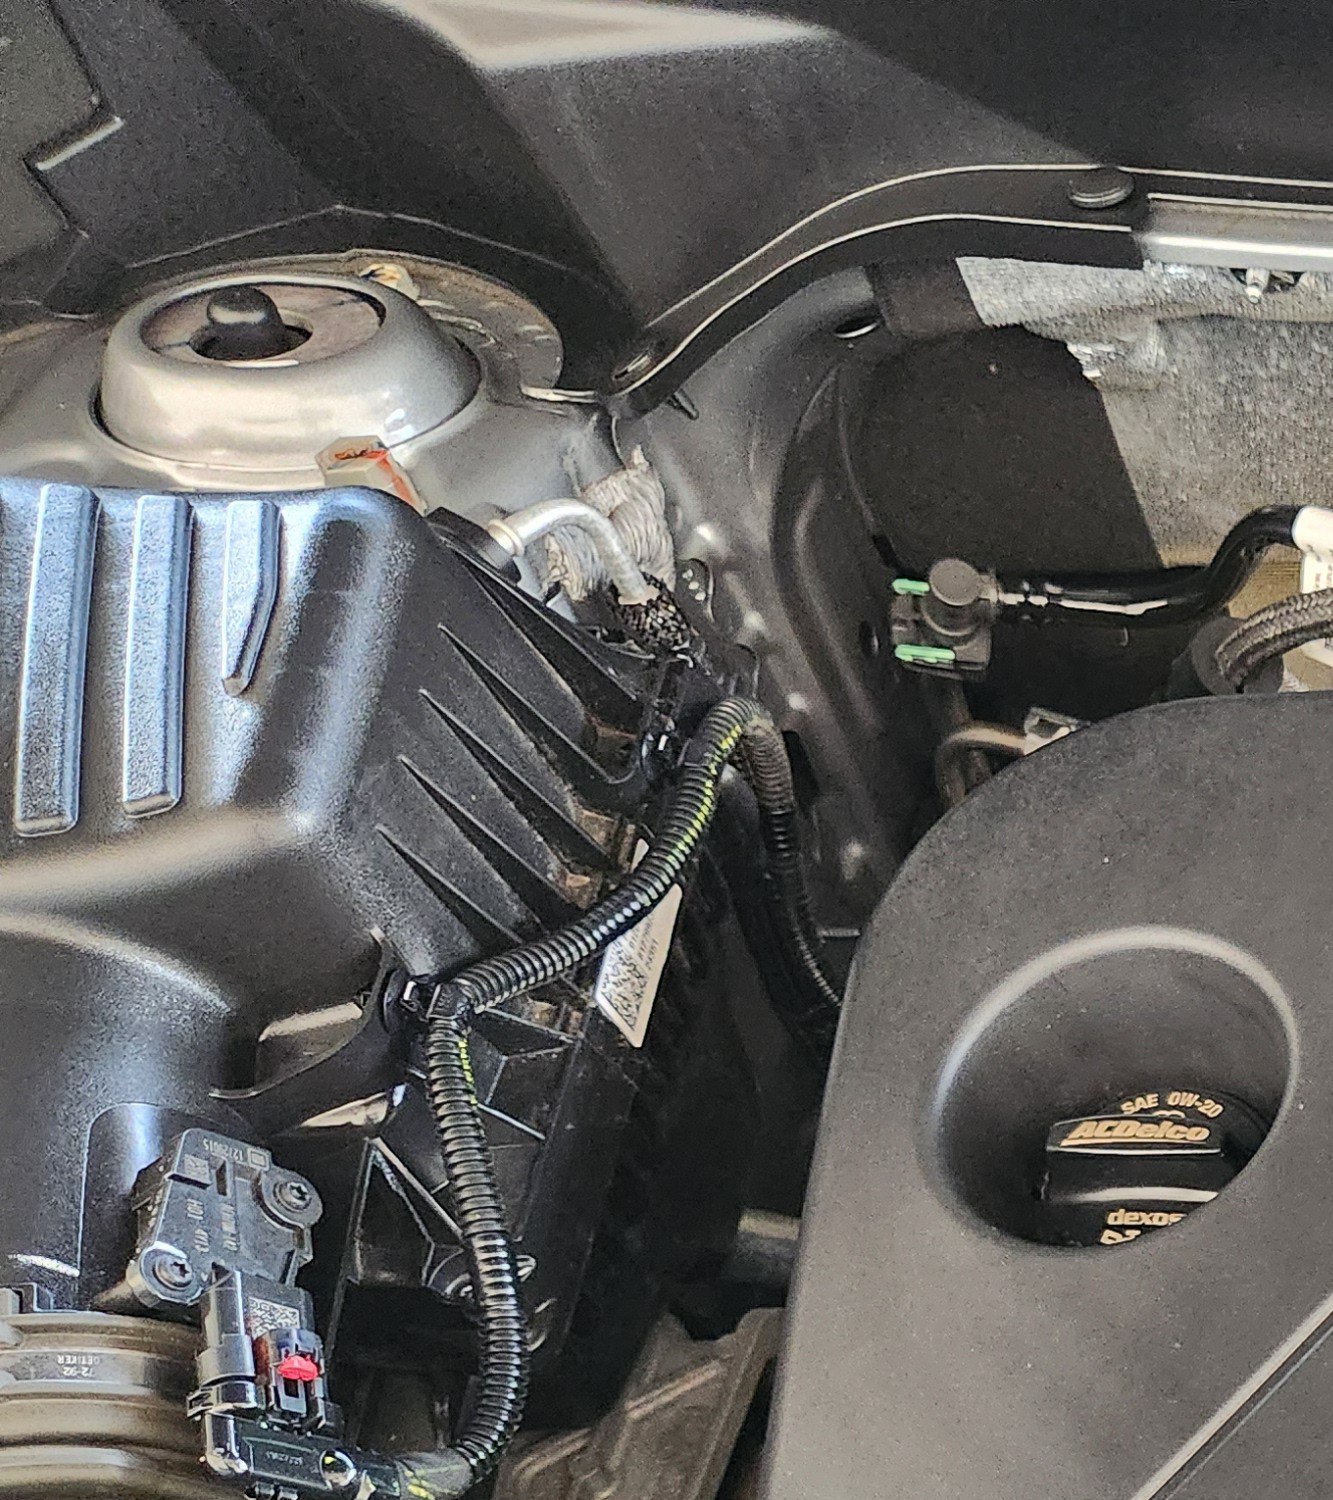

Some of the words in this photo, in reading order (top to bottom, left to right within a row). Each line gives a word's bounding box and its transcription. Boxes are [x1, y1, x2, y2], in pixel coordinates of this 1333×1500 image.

[1121, 1093, 1159, 1115] SAE
[1167, 1091, 1224, 1118] 0W-20
[1068, 1120, 1210, 1141] ACDelco
